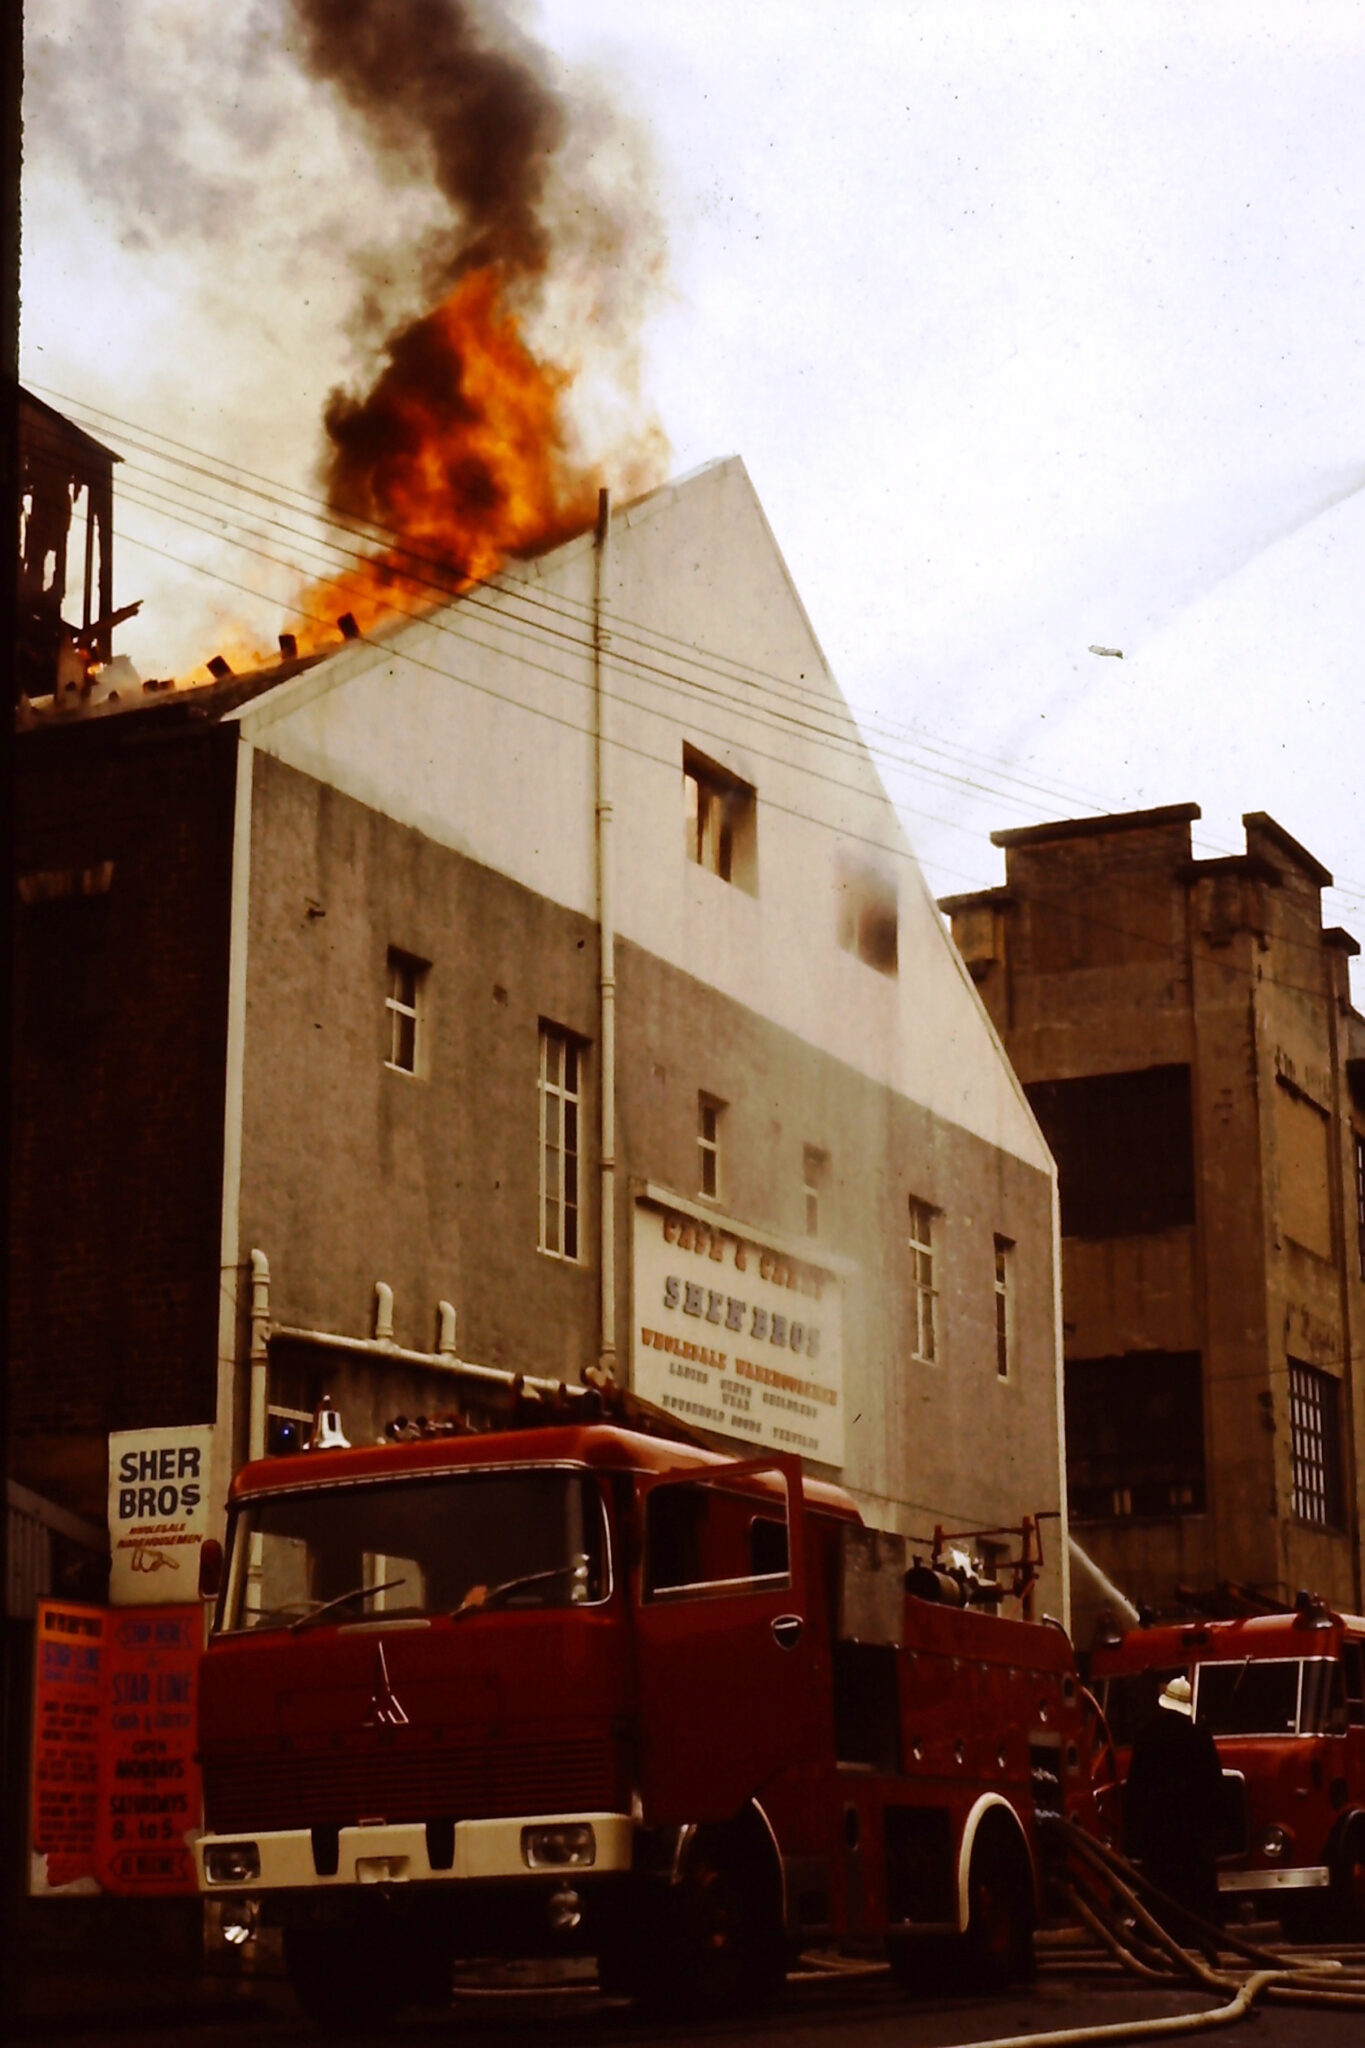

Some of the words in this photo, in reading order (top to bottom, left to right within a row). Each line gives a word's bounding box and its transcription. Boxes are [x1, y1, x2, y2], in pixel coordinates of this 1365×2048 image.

[664, 1275, 746, 1332] SHER
[750, 1306, 821, 1358] BROS
[641, 1327, 727, 1371] WHOLESALE
[669, 1362, 708, 1385] LADIES
[118, 1447, 201, 1484] SHER
